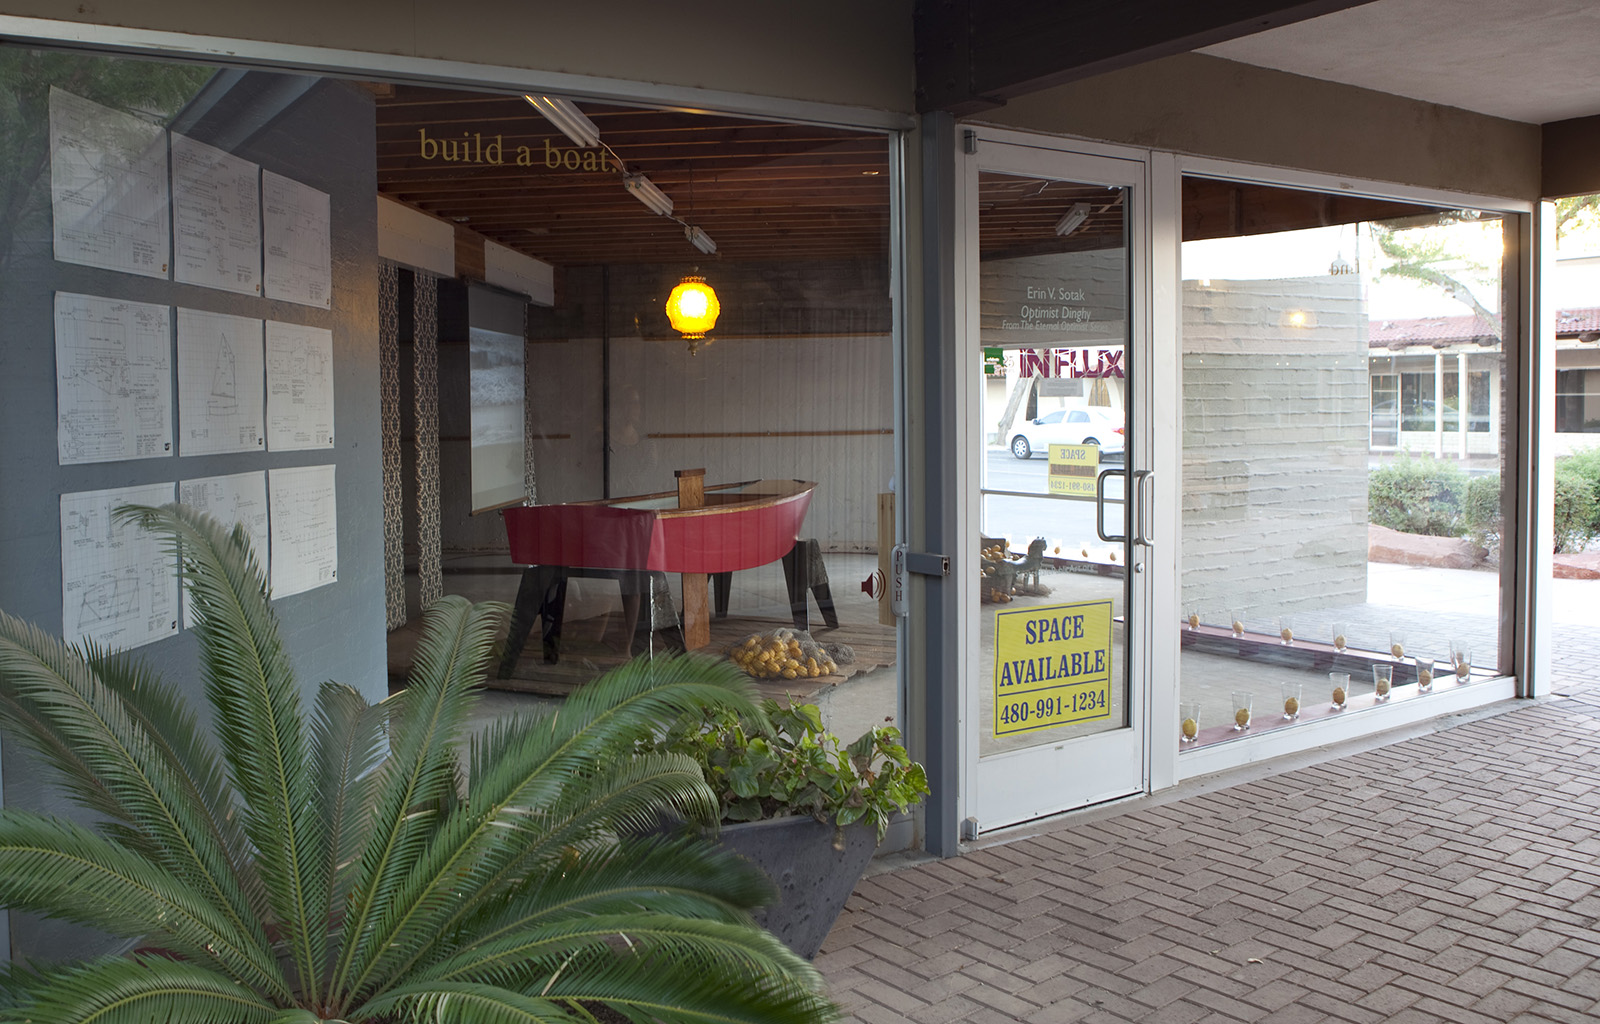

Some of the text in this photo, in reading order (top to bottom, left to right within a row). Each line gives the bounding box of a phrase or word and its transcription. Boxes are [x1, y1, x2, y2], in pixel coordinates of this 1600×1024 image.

[418, 127, 617, 173] build a boat.
[1027, 286, 1085, 301] Erin V. Sotak
[1002, 320, 1019, 330] From
[1020, 320, 1034, 330] The
[1021, 305, 1092, 322] Optimist Dinghy
[895, 550, 903, 602] PUSH
[1025, 615, 1084, 645] SPACE
[1000, 649, 1105, 687] AVAILABLE
[1000, 689, 1105, 724] 480-991-1234
